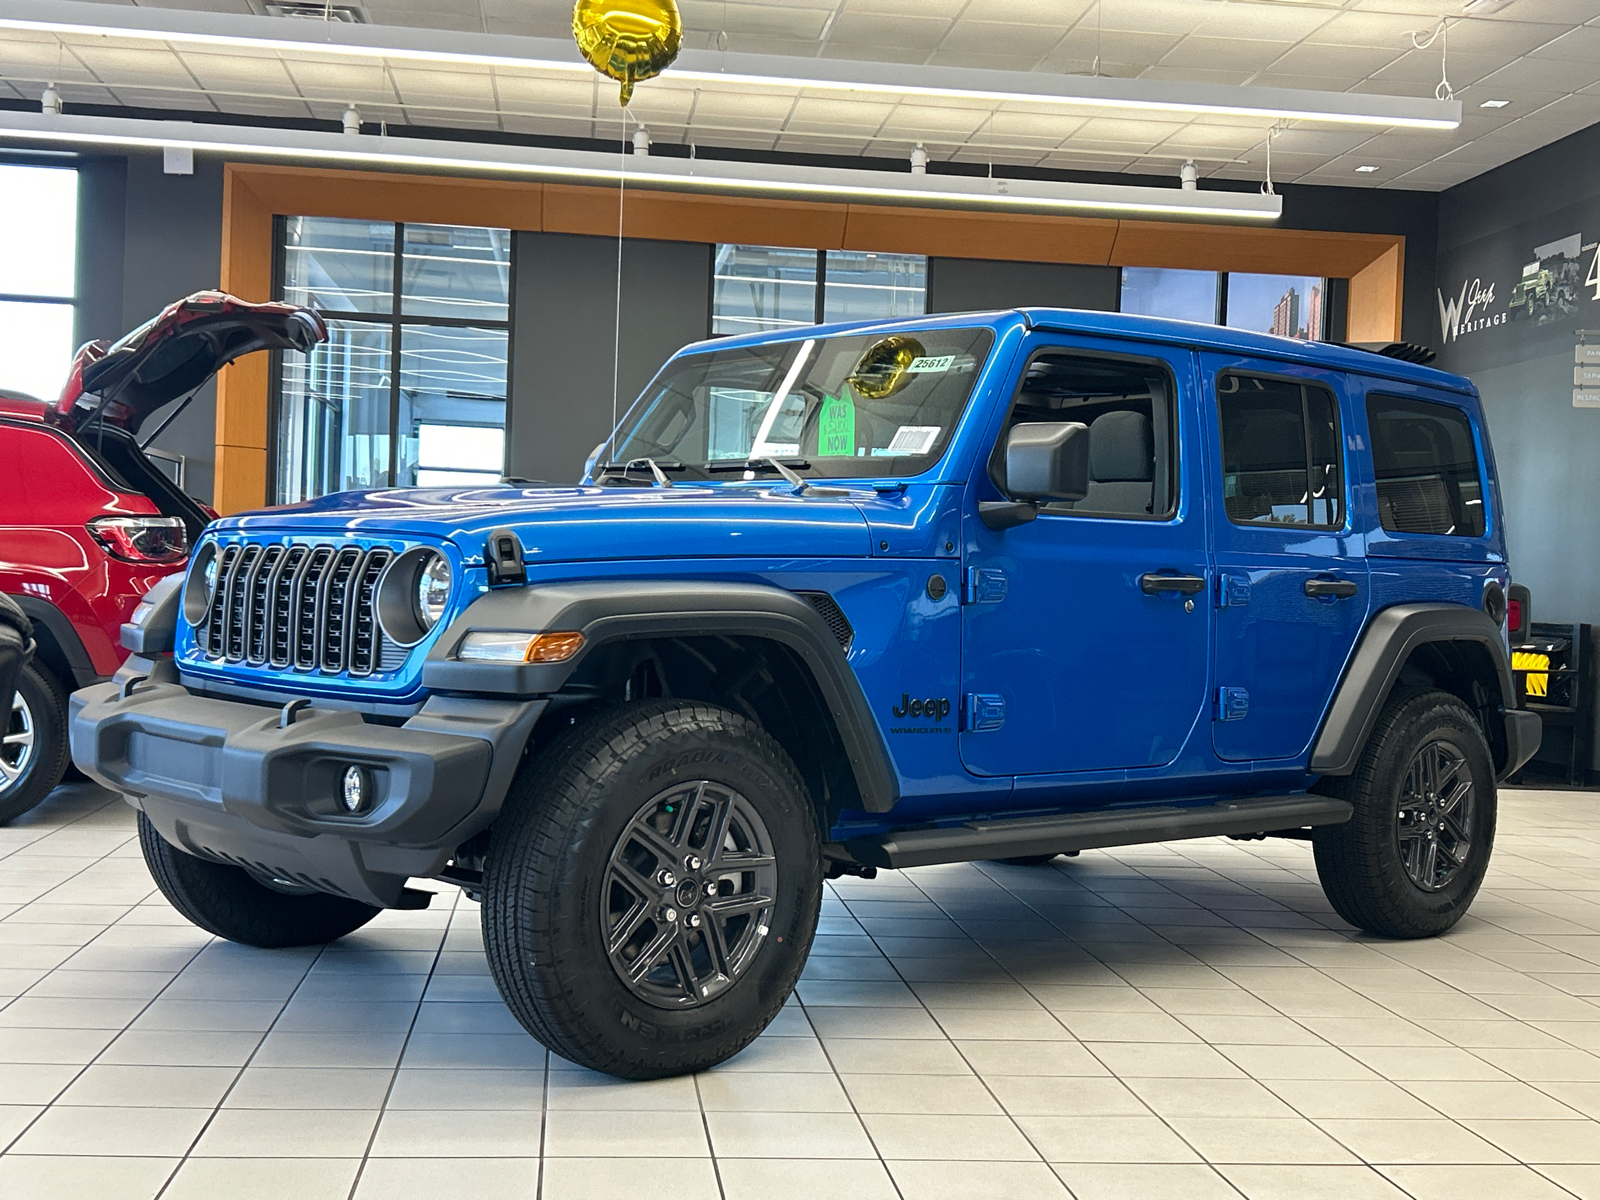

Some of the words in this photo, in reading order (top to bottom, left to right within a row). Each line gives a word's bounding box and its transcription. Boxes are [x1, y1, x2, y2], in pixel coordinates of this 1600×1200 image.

[1464, 278, 1496, 325] Jeep
[1453, 312, 1507, 337] HERITAGE
[915, 358, 949, 368] 25612
[829, 404, 847, 420] WAS
[827, 434, 848, 452] NOW
[892, 692, 951, 722] Jeep
[890, 727, 943, 735] WRANGLER
